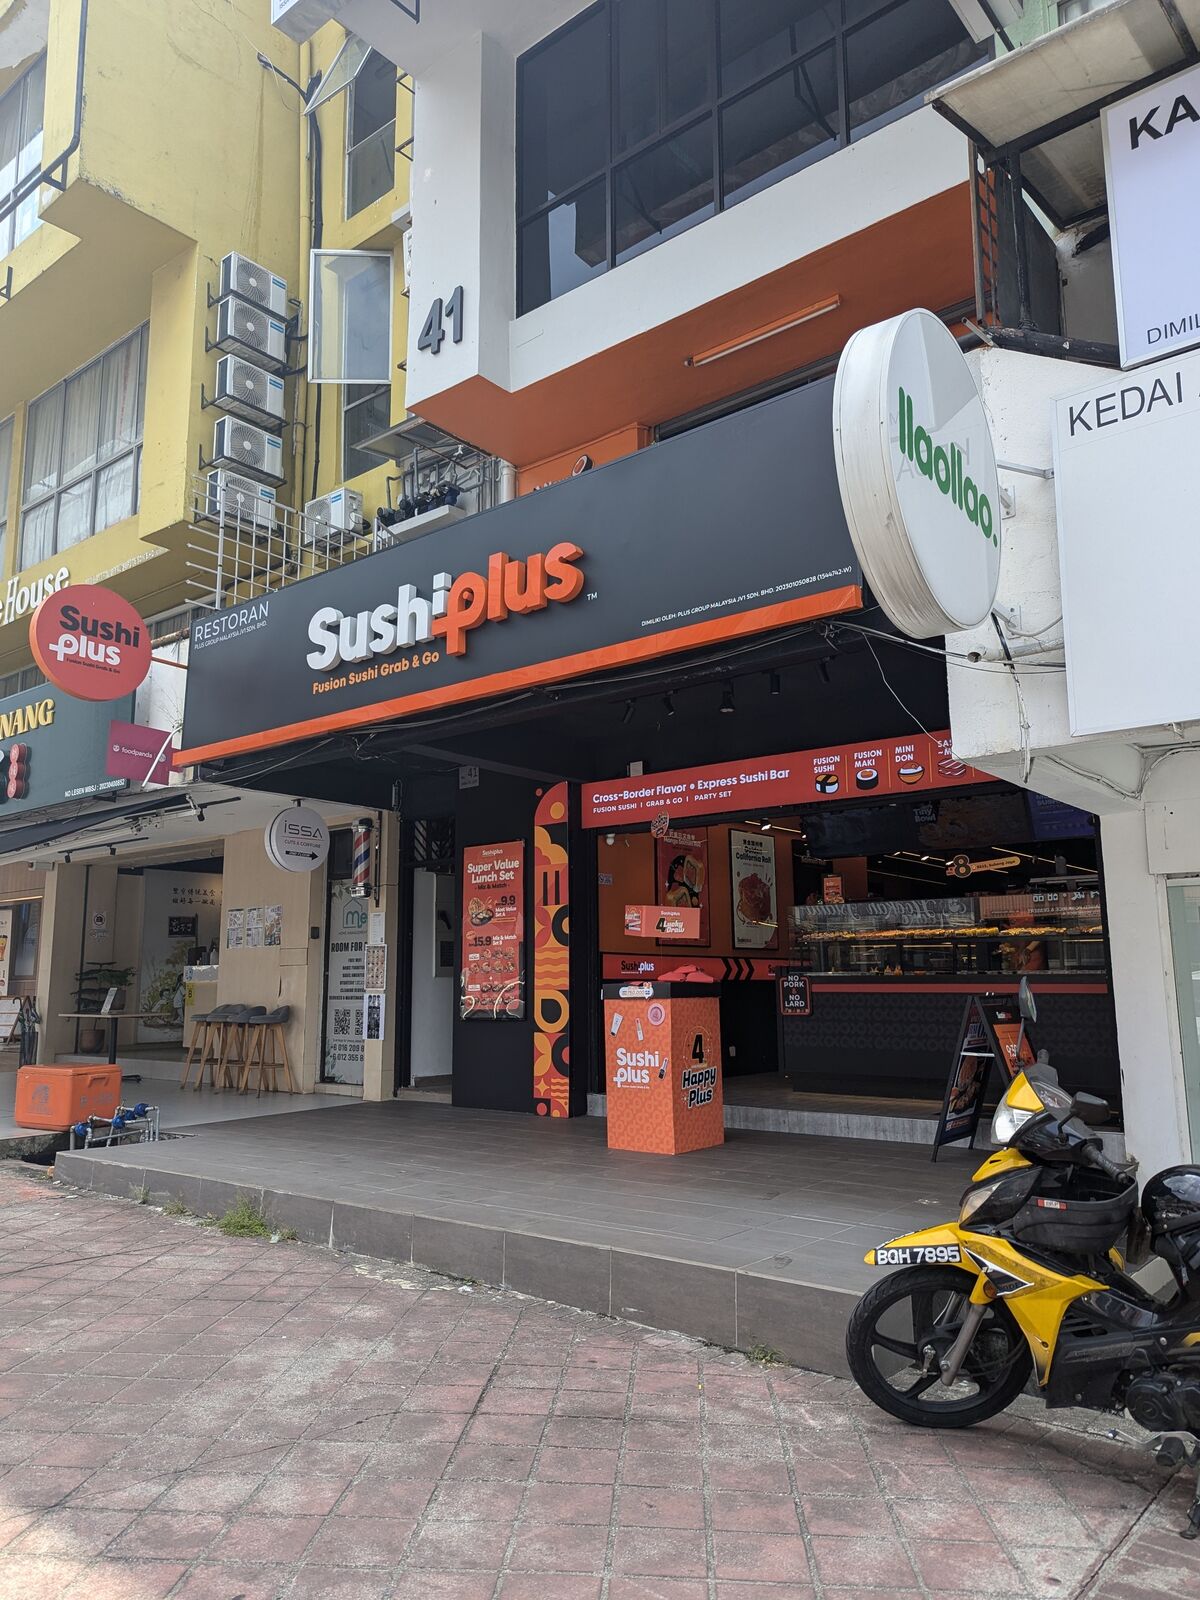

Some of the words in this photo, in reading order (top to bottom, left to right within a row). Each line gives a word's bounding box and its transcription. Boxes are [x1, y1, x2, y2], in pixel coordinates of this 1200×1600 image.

[1129, 94, 1200, 150] KA
[417, 285, 464, 355] 41
[1068, 371, 1183, 437] KEDAI
[4, 566, 70, 624] House
[586, 591, 598, 601] TM
[641, 617, 661, 627] DIMILIKI
[677, 609, 691, 617] PLUS
[691, 604, 710, 614] GROUP
[710, 597, 737, 608] MALAYSIA
[746, 591, 760, 600] SDN.
[59, 605, 140, 648] Sushi
[194, 600, 269, 642] RESTORAN
[48, 633, 121, 666] plus
[194, 641, 205, 650] PLUS
[204, 637, 220, 647] GROUP
[219, 631, 240, 642] MALAYSIA
[312, 676, 347, 695] Fusion
[348, 668, 379, 685] Sushi
[380, 659, 410, 677] Grab
[411, 655, 420, 669] &
[422, 651, 440, 666] Go
[0, 698, 55, 741] NANG
[121, 746, 153, 759] foodpanda
[853, 749, 882, 760] FUSION
[895, 744, 915, 754] MINI
[895, 753, 914, 763] DON
[813, 755, 841, 766] FUSION
[813, 764, 835, 774] SUSHI
[854, 759, 875, 768] MAKI
[467, 767, 477, 777] 41
[593, 788, 655, 804] Cross-Border
[656, 783, 687, 796] Flavor
[697, 776, 738, 791] Express
[739, 771, 769, 784] Sushi
[769, 769, 790, 780] Bar
[593, 805, 617, 814] FUSION
[618, 803, 637, 811] SUSHI
[645, 799, 665, 807] GRAB
[694, 793, 717, 802] PARTY
[718, 790, 732, 798] SET
[467, 863, 493, 874] Super
[493, 859, 520, 870] Value
[736, 852, 762, 863] California
[762, 856, 772, 864] Roll
[471, 871, 498, 884] Lunch
[499, 870, 515, 880] Set
[656, 917, 666, 933] 4
[664, 920, 684, 928] Lucky
[666, 926, 685, 934] Draw
[331, 942, 350, 952] ROOM
[350, 941, 363, 951] FOR
[616, 1047, 660, 1067] Sushi
[691, 1032, 705, 1064] 4
[613, 1067, 650, 1088] plus
[681, 1066, 717, 1089] Happy
[687, 1089, 713, 1109] Plus
[877, 1248, 912, 1265] BQH
[913, 1246, 961, 1263] 7895
